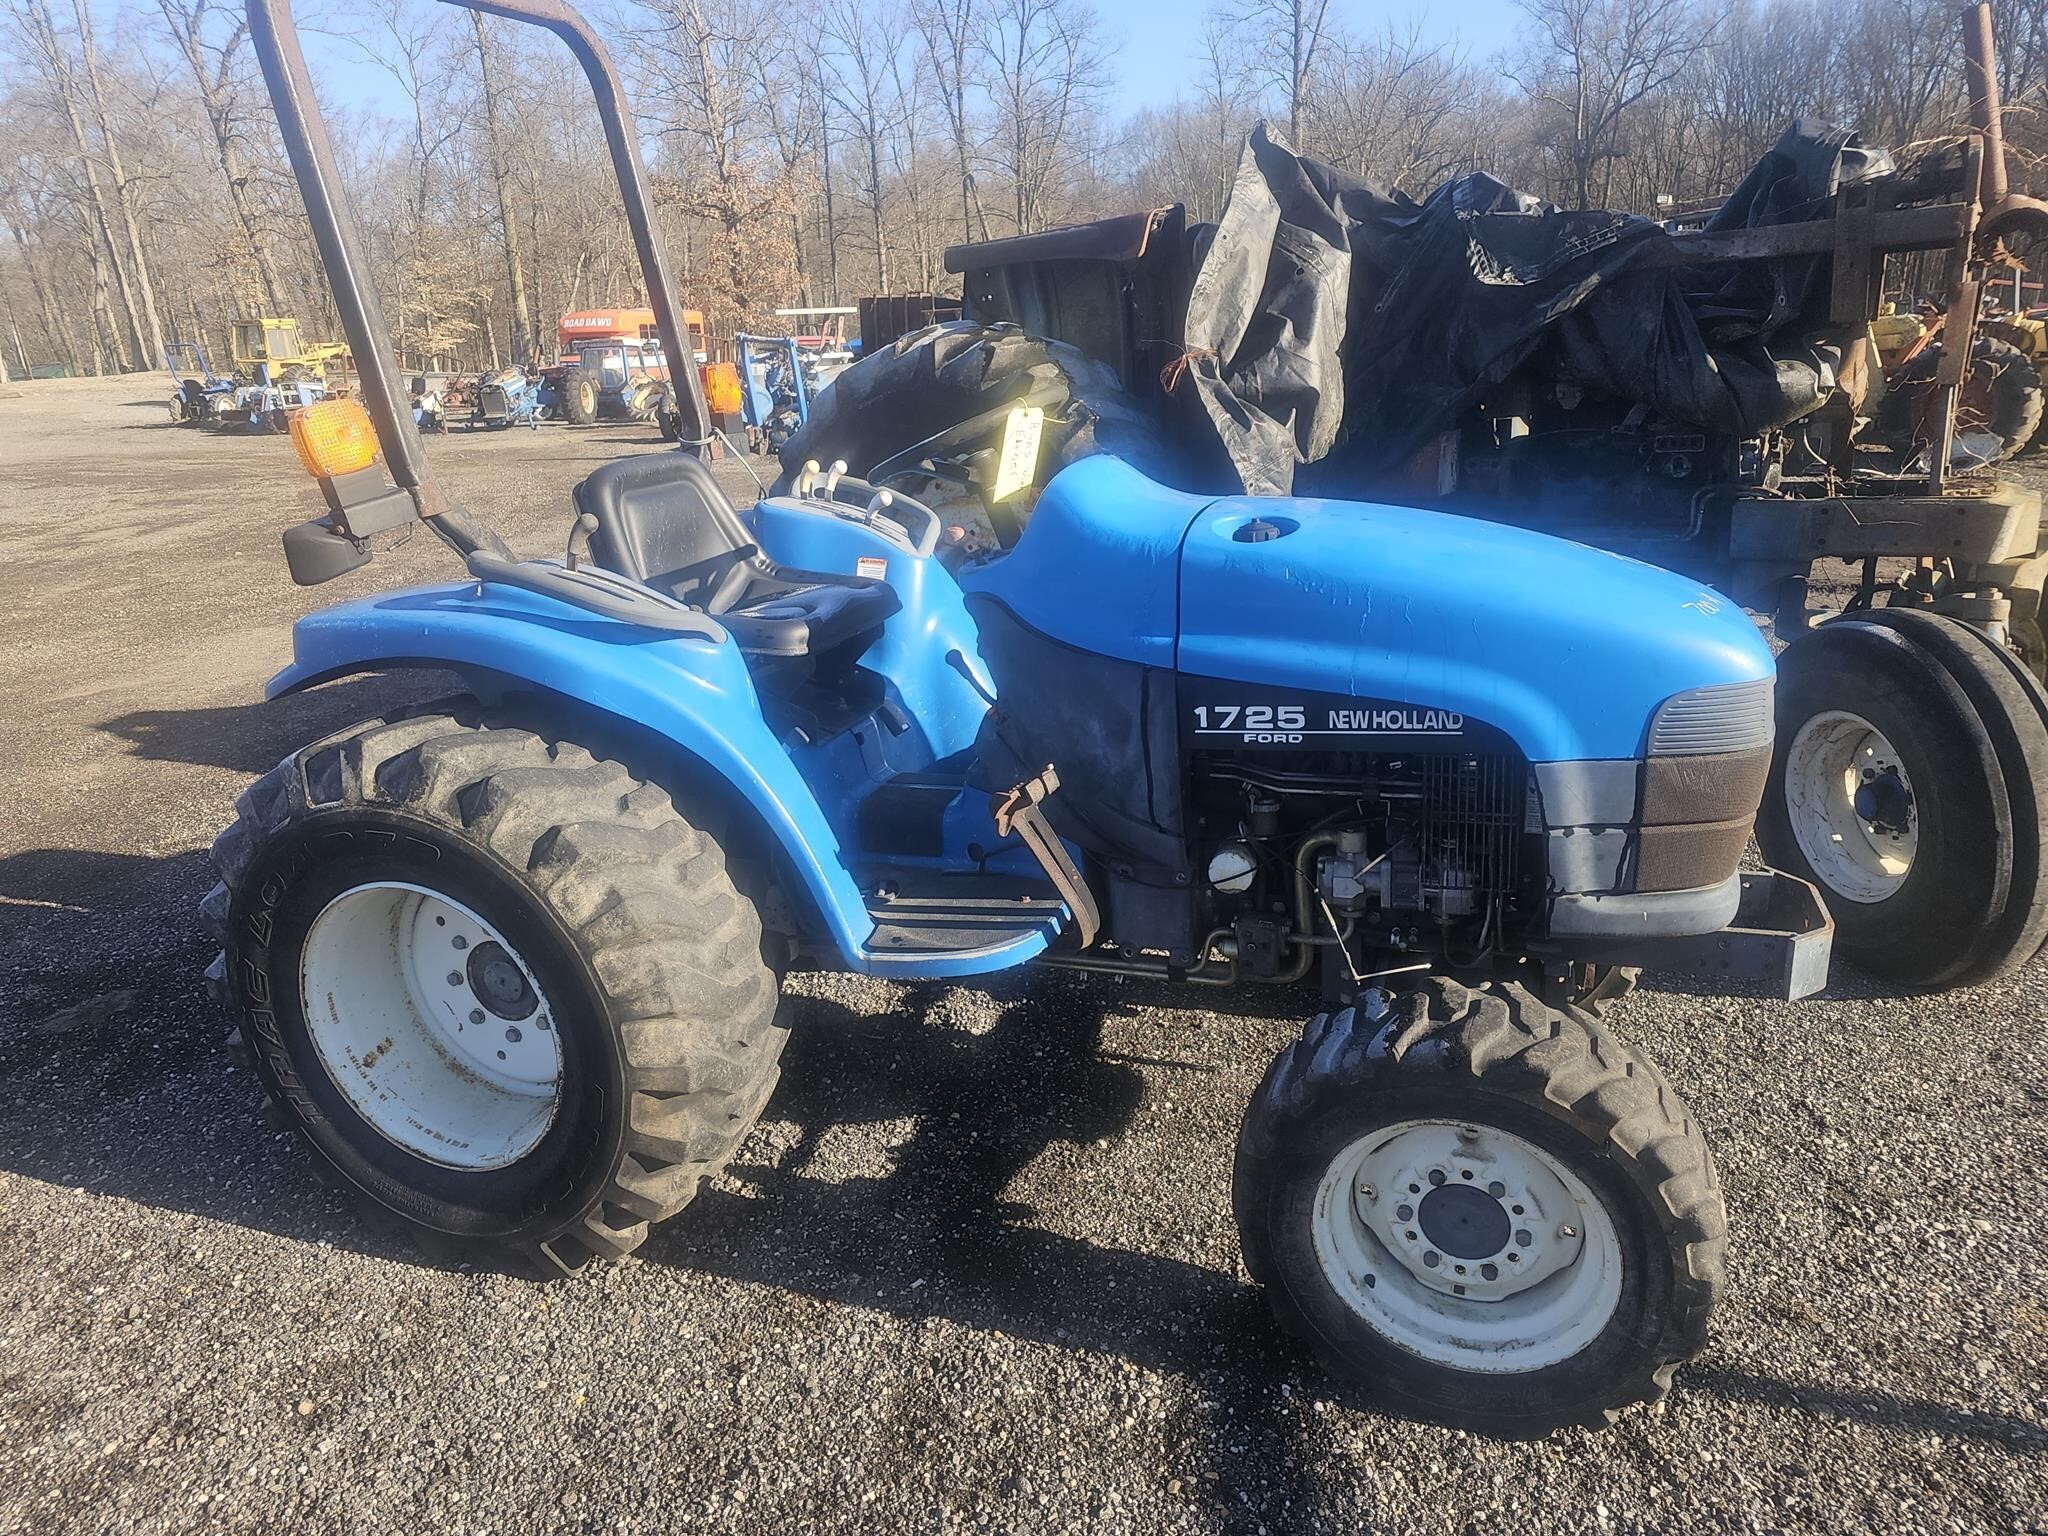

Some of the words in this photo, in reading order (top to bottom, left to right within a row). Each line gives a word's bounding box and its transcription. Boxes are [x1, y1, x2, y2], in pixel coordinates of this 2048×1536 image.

[563, 319, 585, 328] ROAD
[1193, 705, 1306, 730] 1725
[1243, 733, 1303, 744] FORD
